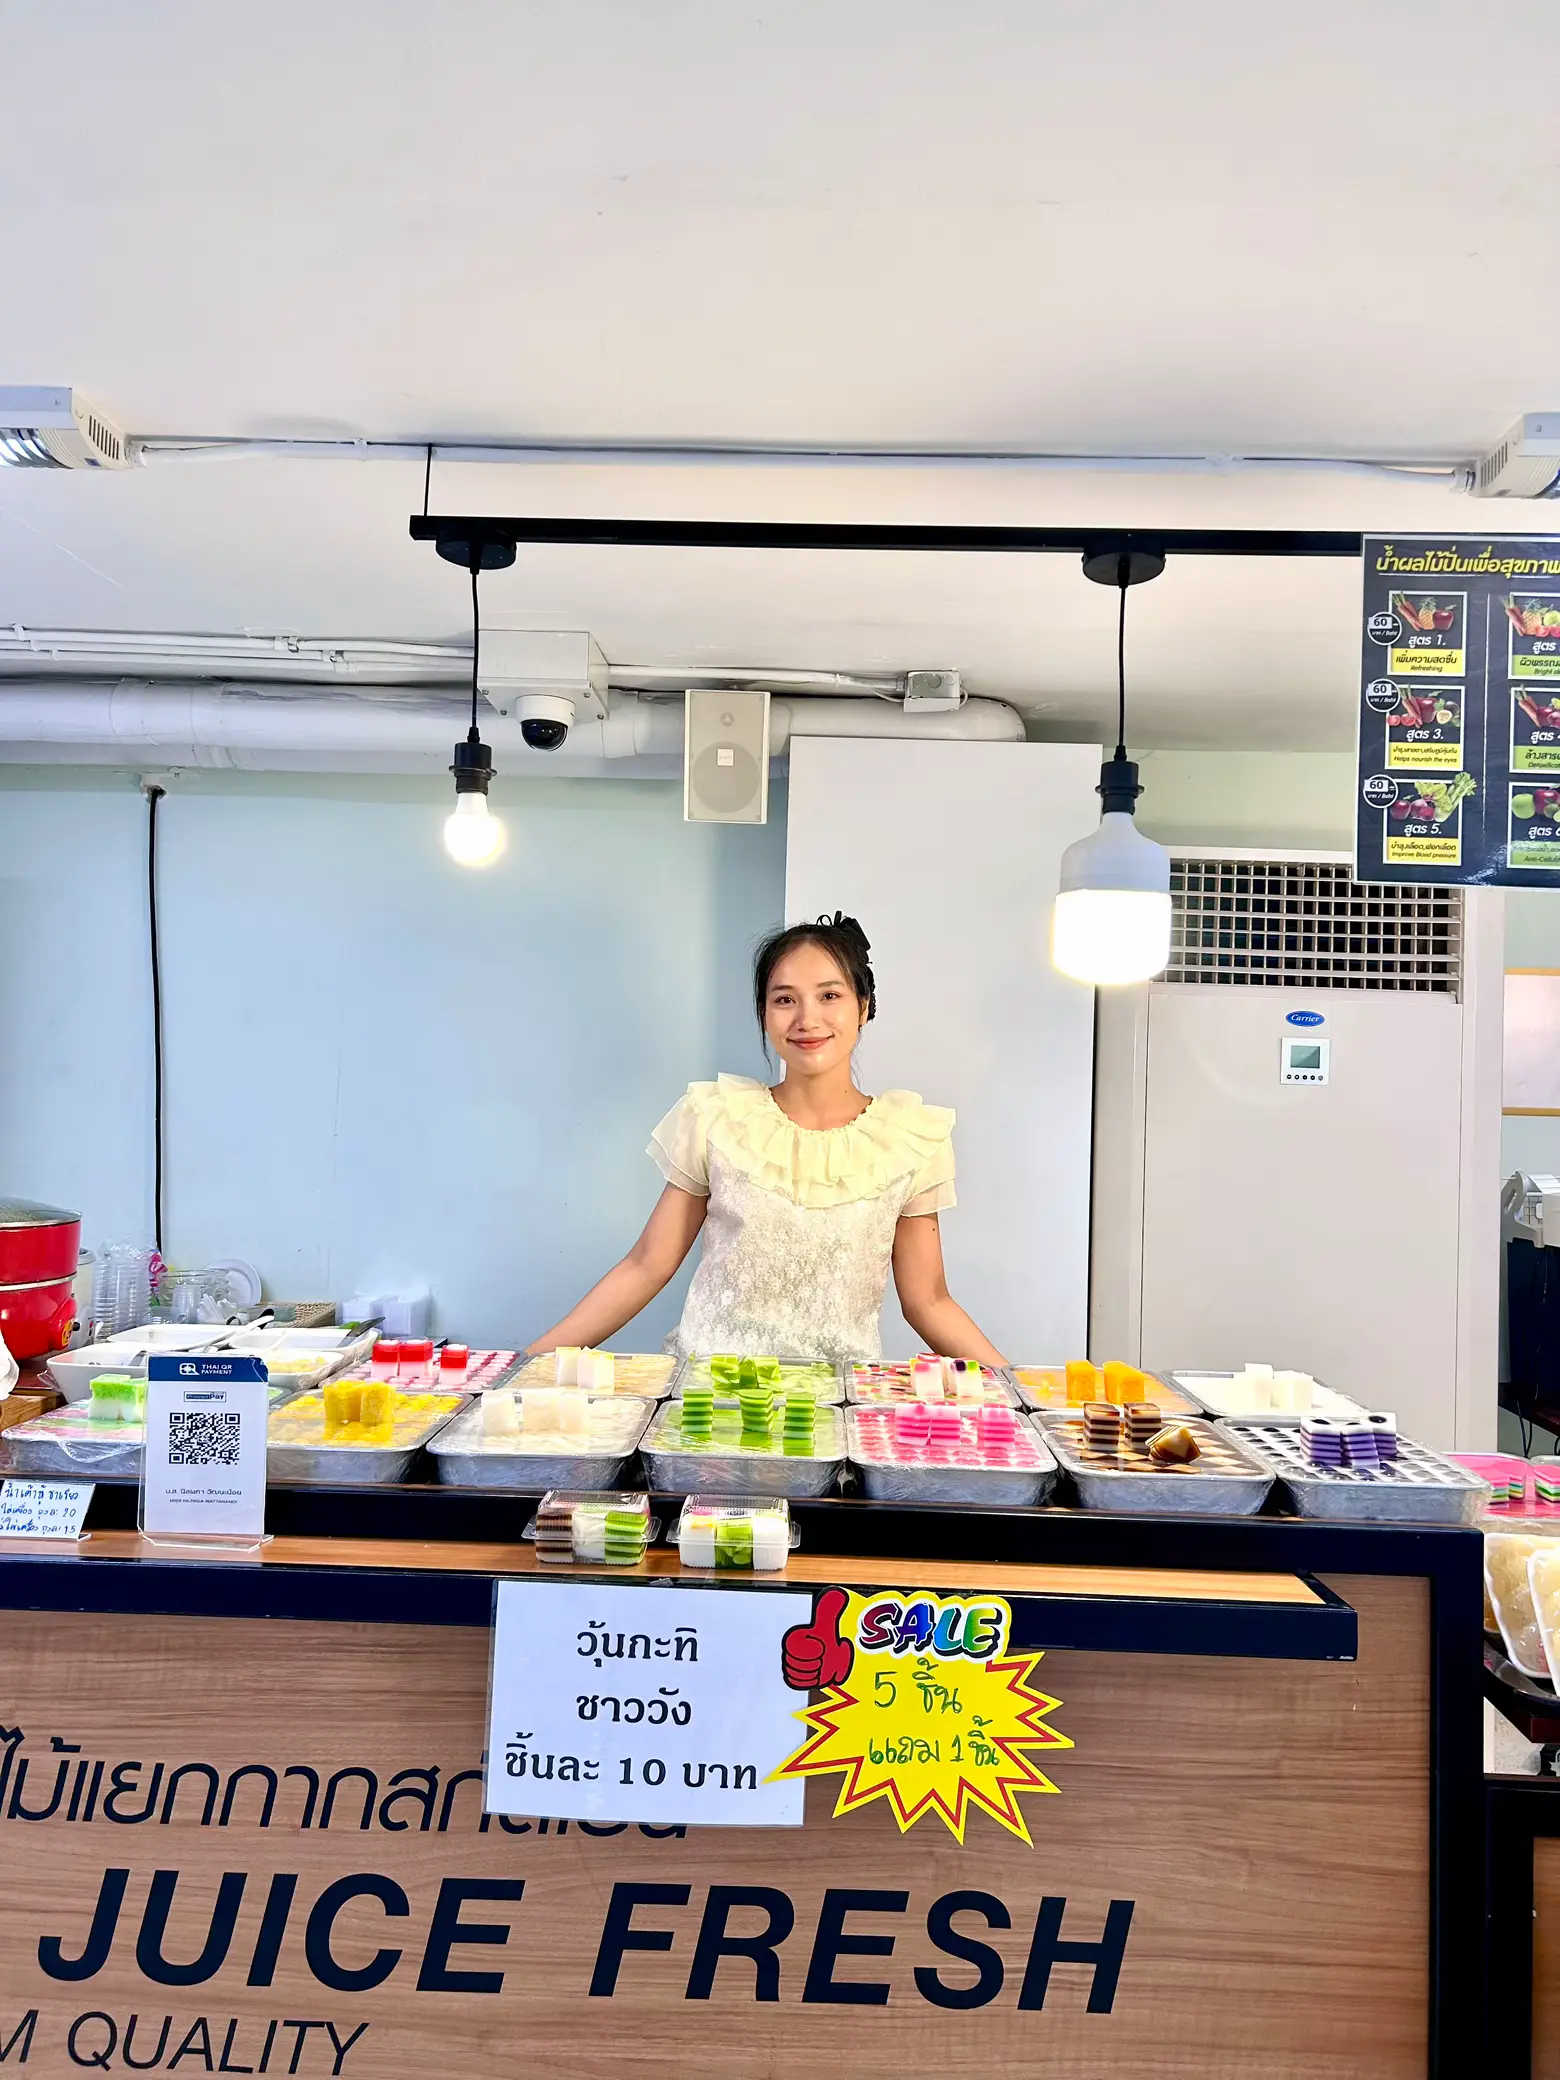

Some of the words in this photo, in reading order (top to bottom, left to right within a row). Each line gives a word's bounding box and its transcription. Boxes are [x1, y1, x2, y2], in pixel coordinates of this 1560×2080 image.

[1374, 617, 1387, 627] 60
[1408, 635, 1432, 648] สูตร
[1437, 634, 1446, 646] 1.
[1532, 640, 1556, 654] สูตร
[1396, 650, 1457, 664] เพิ่มความสดชื่น
[1373, 684, 1387, 694] 60
[1406, 729, 1430, 742] สูตร
[1432, 728, 1444, 740] 3.
[1530, 731, 1554, 744] สูตร
[1370, 780, 1384, 790] 60
[1404, 824, 1428, 837] สูตร
[1430, 823, 1442, 834] 5.
[1528, 826, 1552, 839] สูตร
[1290, 1014, 1320, 1022] Carrier
[62, 1507, 76, 1518] 20
[65, 1526, 76, 1534] 15
[860, 1602, 1003, 1659] SALE
[577, 1620, 698, 1668] วุ้นกะทิ
[874, 1671, 897, 1708] 5
[912, 1657, 962, 1714] ชิ้น
[576, 1687, 692, 1726] ชาววัง
[869, 1736, 940, 1764] แถม
[950, 1734, 964, 1762] 1
[968, 1716, 1000, 1766] ชิ้น
[506, 1732, 600, 1782] ชิ้นละ
[620, 1757, 666, 1786] 10
[683, 1762, 758, 1790] บาท
[37, 1868, 526, 1994] JUICE
[588, 1882, 1136, 2014] FRESH
[68, 2012, 370, 2076] QUALITY
